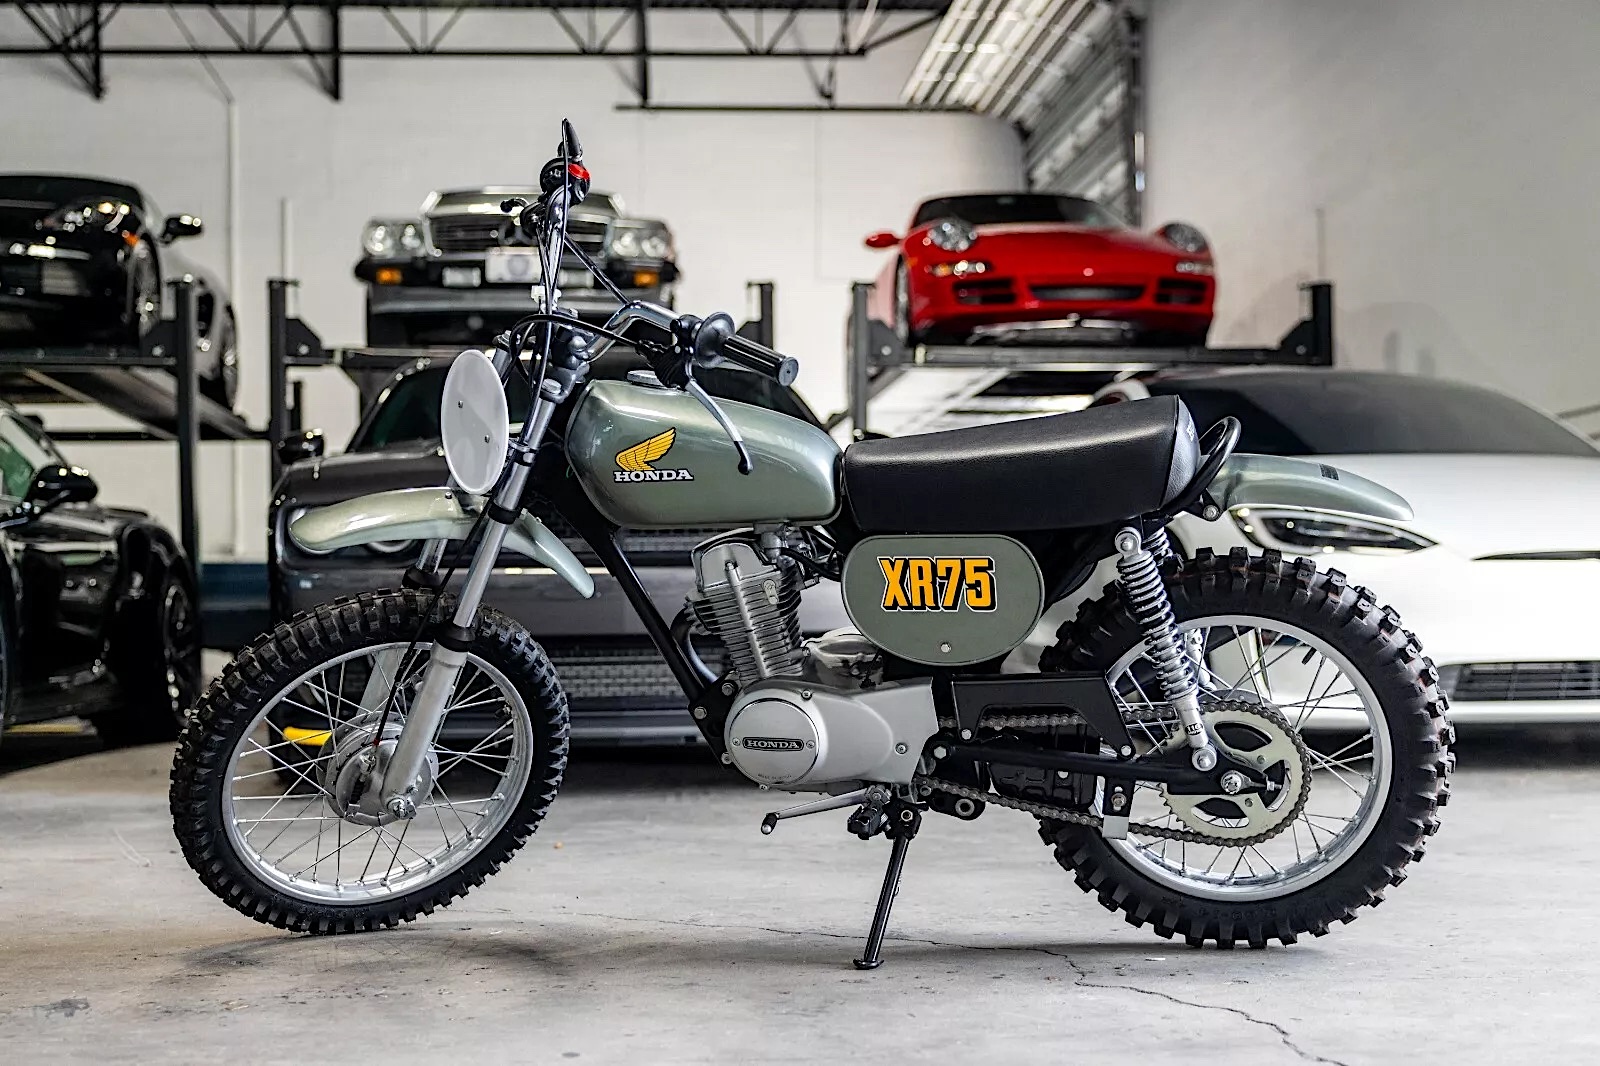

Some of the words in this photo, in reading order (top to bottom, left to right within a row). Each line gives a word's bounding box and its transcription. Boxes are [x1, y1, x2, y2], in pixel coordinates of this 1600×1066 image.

[613, 468, 694, 483] HONDA
[877, 556, 998, 612] XR75
[746, 739, 800, 749] HONDA
